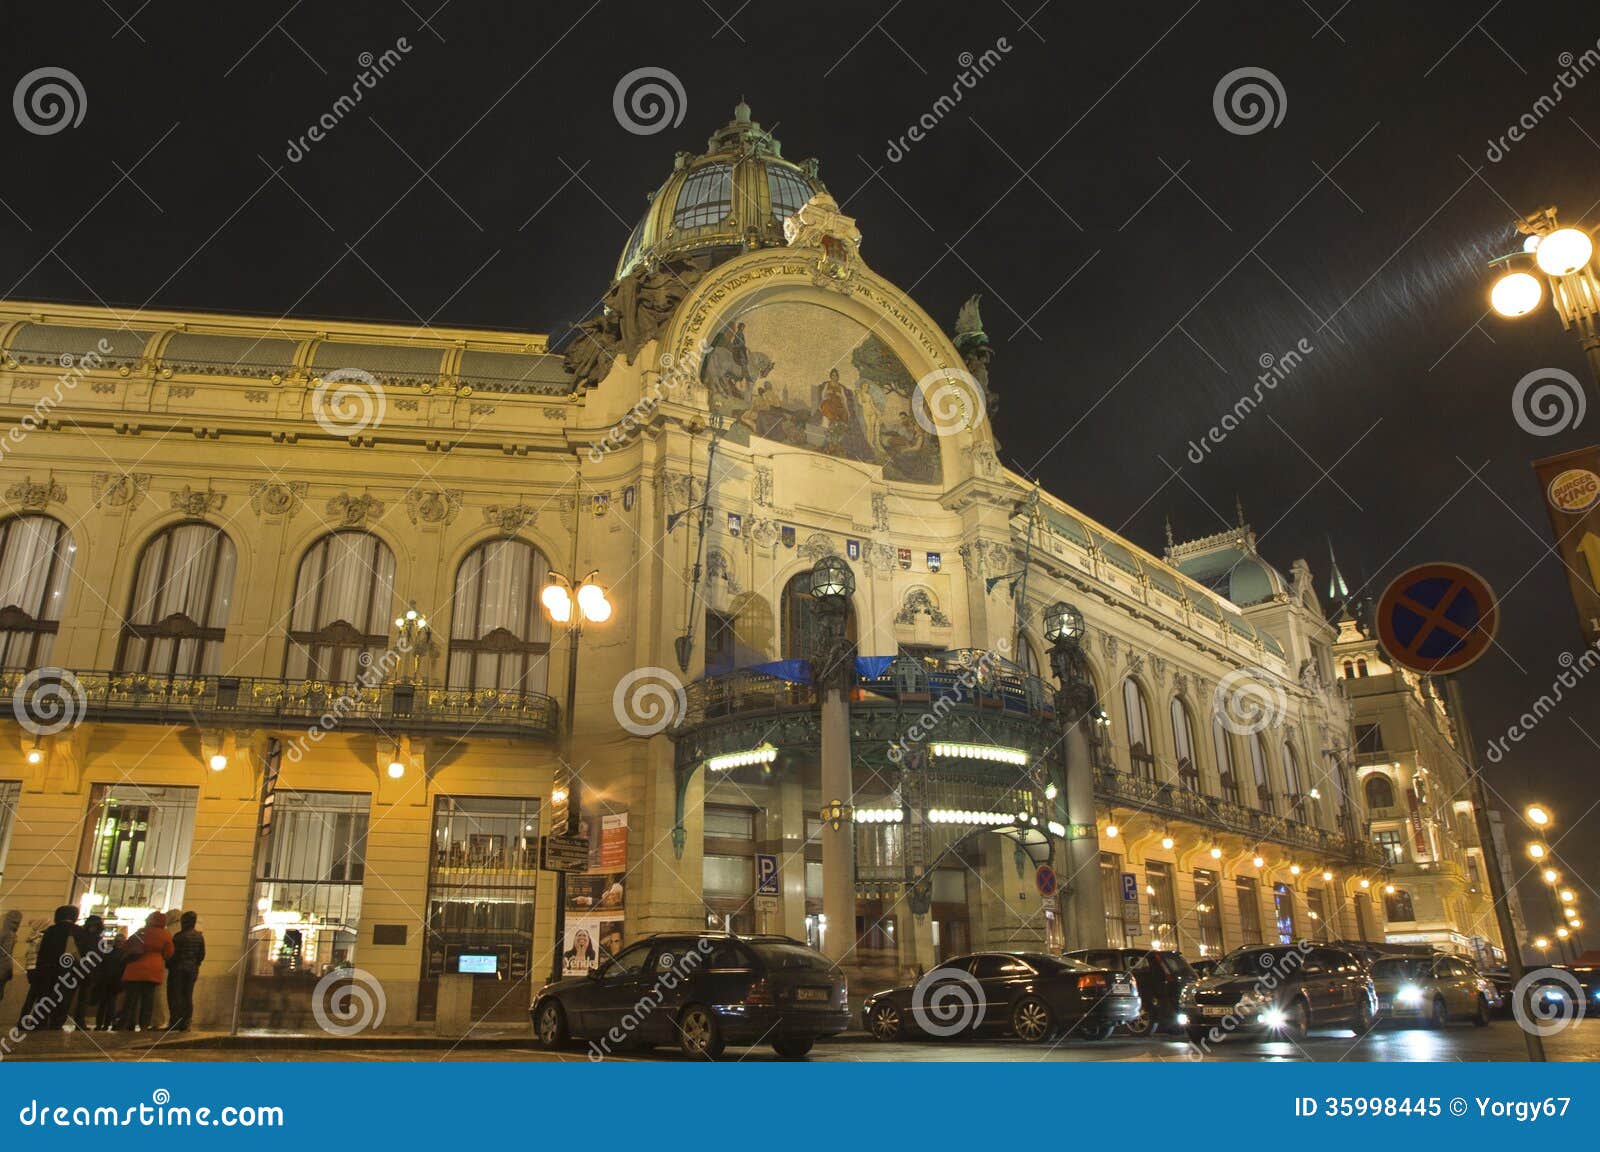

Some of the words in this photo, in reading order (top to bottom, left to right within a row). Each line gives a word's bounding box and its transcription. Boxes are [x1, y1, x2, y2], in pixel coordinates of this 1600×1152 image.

[1554, 473, 1593, 498] BURGER
[1558, 480, 1597, 507] KING
[761, 858, 774, 882] P
[1124, 876, 1134, 892] P
